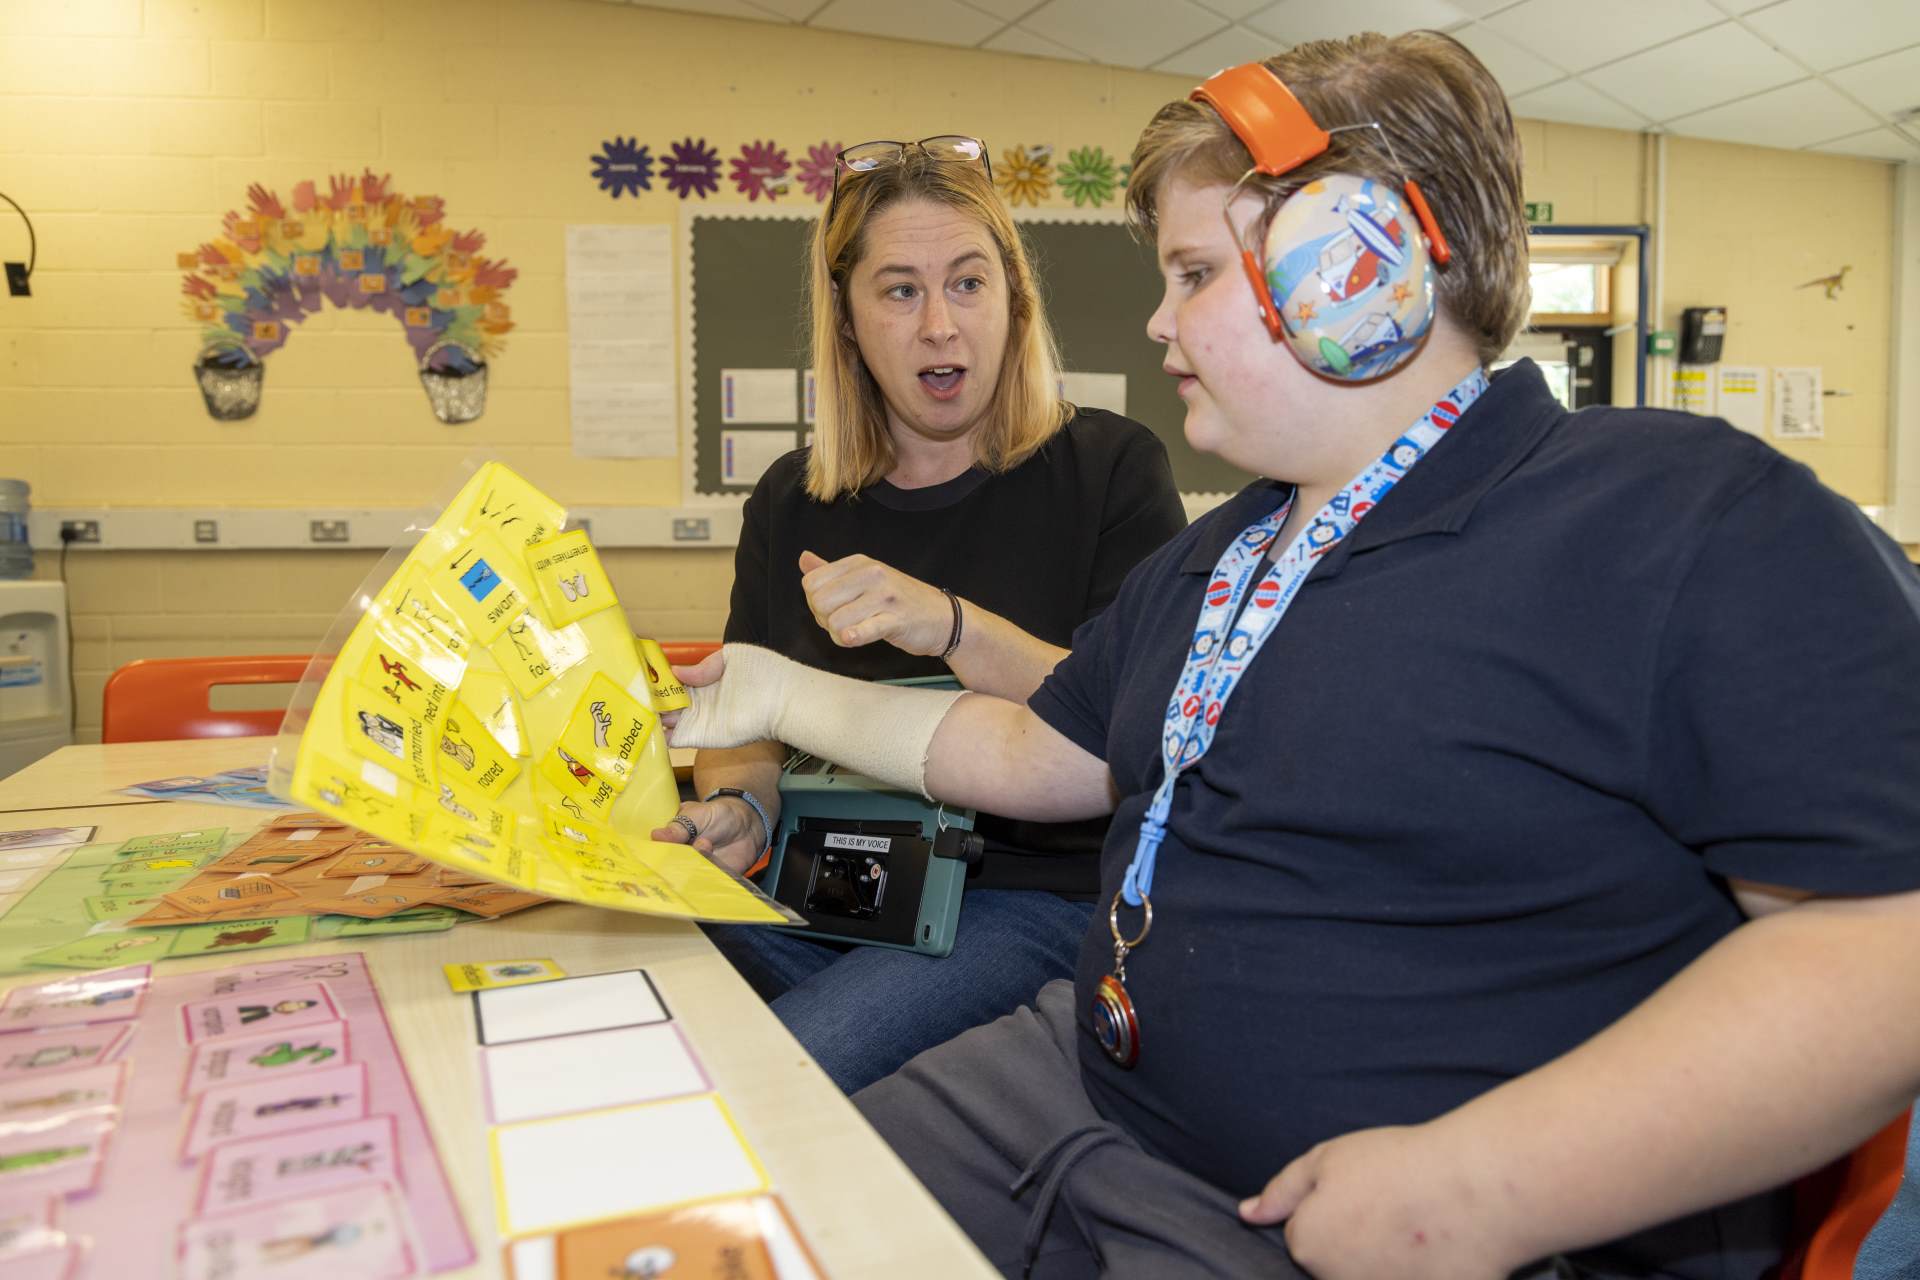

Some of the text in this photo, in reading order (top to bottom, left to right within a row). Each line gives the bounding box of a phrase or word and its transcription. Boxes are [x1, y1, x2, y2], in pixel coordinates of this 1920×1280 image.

[1214, 568, 1228, 579] T
[1268, 567, 1283, 578] T
[670, 684, 685, 696] fire
[412, 718, 423, 763] married
[478, 760, 504, 789] roared
[591, 781, 613, 808] hugg
[832, 836, 889, 850] THIS IS MY VOICE
